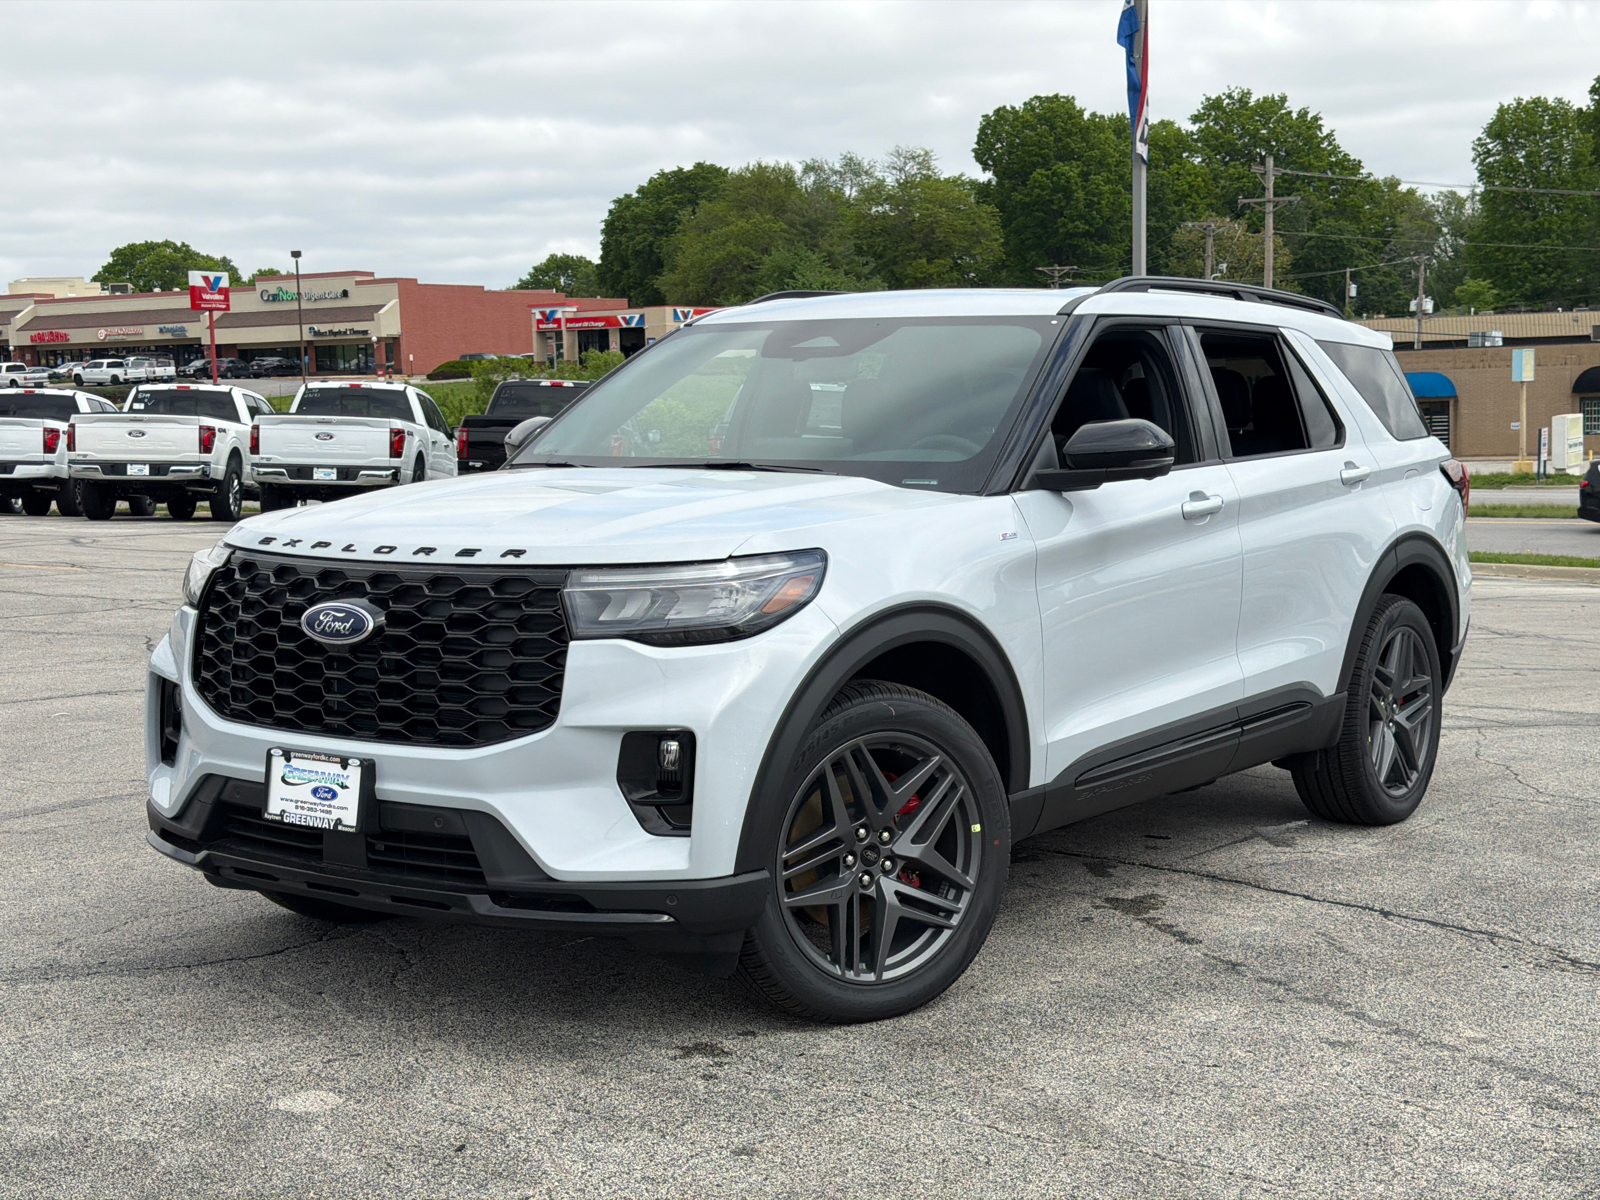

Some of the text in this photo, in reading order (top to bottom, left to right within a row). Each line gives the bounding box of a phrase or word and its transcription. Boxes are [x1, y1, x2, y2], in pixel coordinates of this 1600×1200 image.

[303, 291, 325, 301] Urgent
[326, 290, 341, 300] Care
[258, 536, 528, 559] EXPLORER
[314, 610, 355, 635] Ford
[290, 751, 341, 763] greenwayfordkc.com
[282, 763, 350, 787] GREENWAY
[316, 787, 332, 799] Ford
[280, 796, 349, 811] www.greenwayfordkc.com
[264, 812, 356, 833] Raytown GREENWAY Missouri
